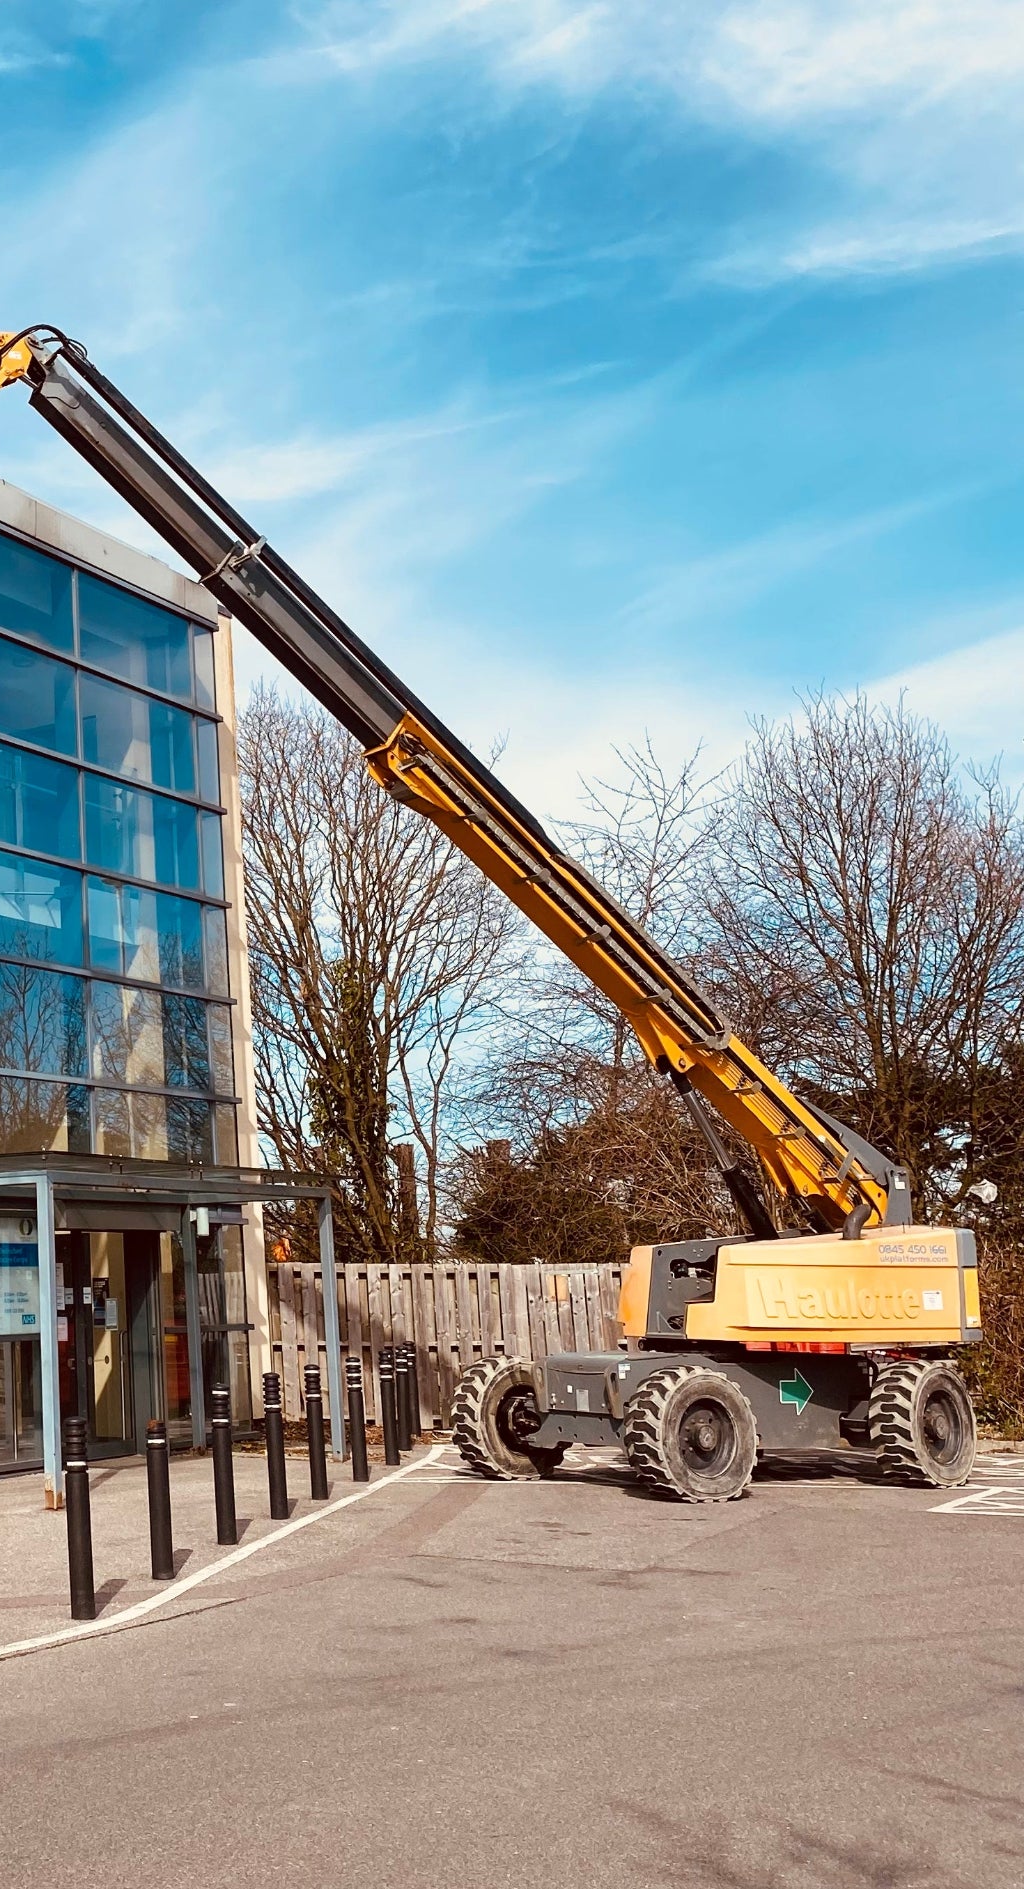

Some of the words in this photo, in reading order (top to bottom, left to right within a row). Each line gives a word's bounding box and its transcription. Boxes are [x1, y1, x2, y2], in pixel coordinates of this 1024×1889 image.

[878, 1244, 905, 1254] 0845
[907, 1244, 926, 1254] 450
[929, 1244, 947, 1254] 1661
[879, 1255, 949, 1264] ukplatforms.com
[757, 1278, 921, 1319] Haulotte
[23, 1315, 35, 1324] NHS
